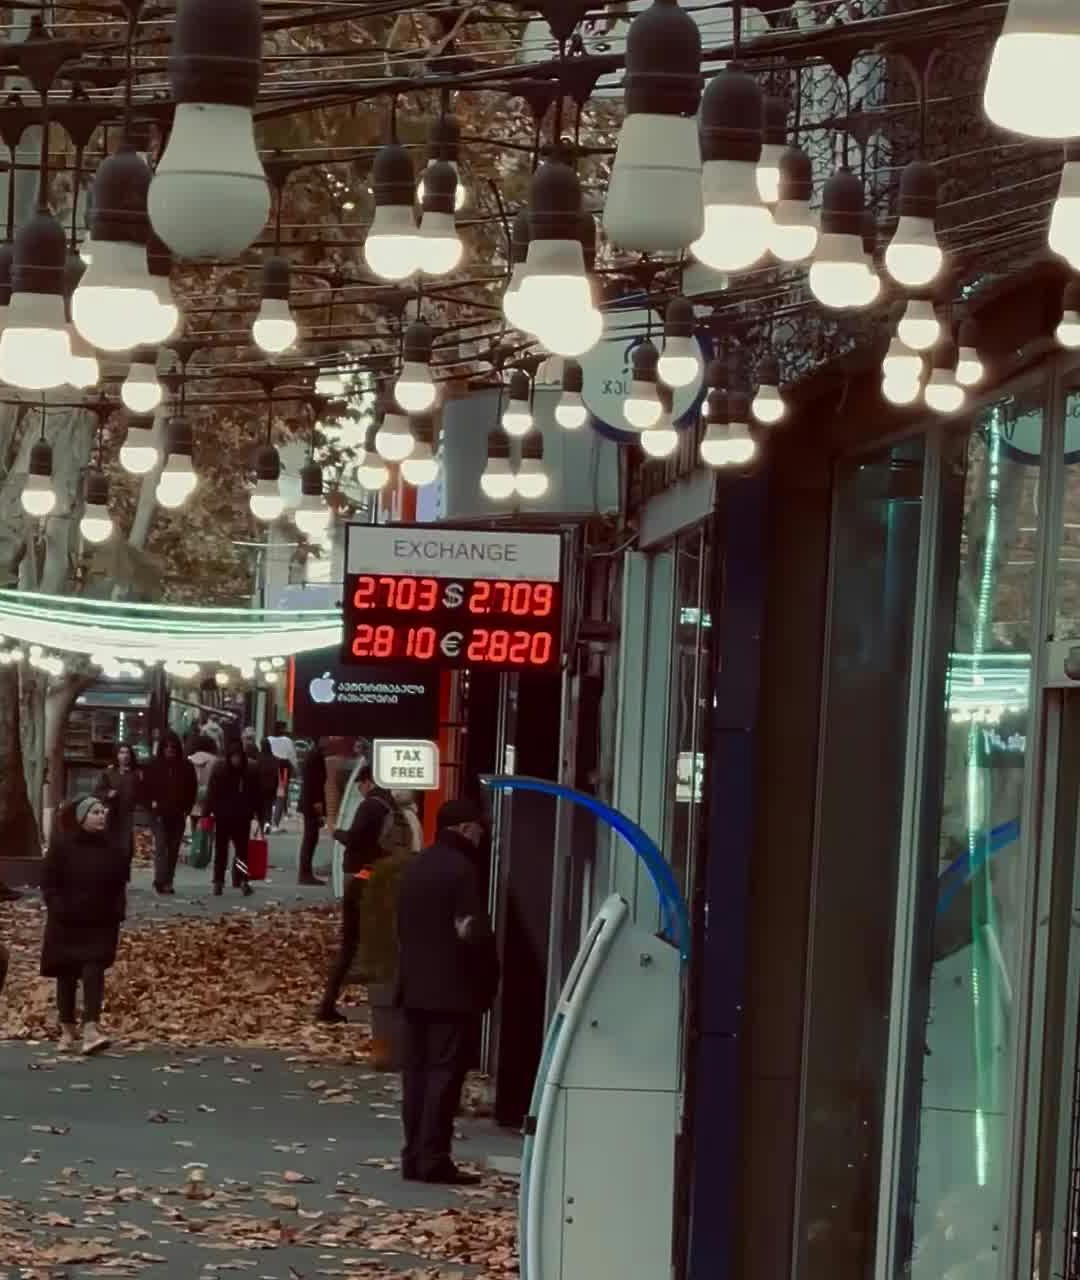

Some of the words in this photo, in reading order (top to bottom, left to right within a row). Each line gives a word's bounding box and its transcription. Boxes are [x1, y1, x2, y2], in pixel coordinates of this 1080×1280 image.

[393, 540, 519, 561] EXCHANGE
[442, 583, 464, 608] $
[440, 632, 464, 657] €
[394, 749, 421, 761] TAX
[390, 766, 425, 778] FREE
